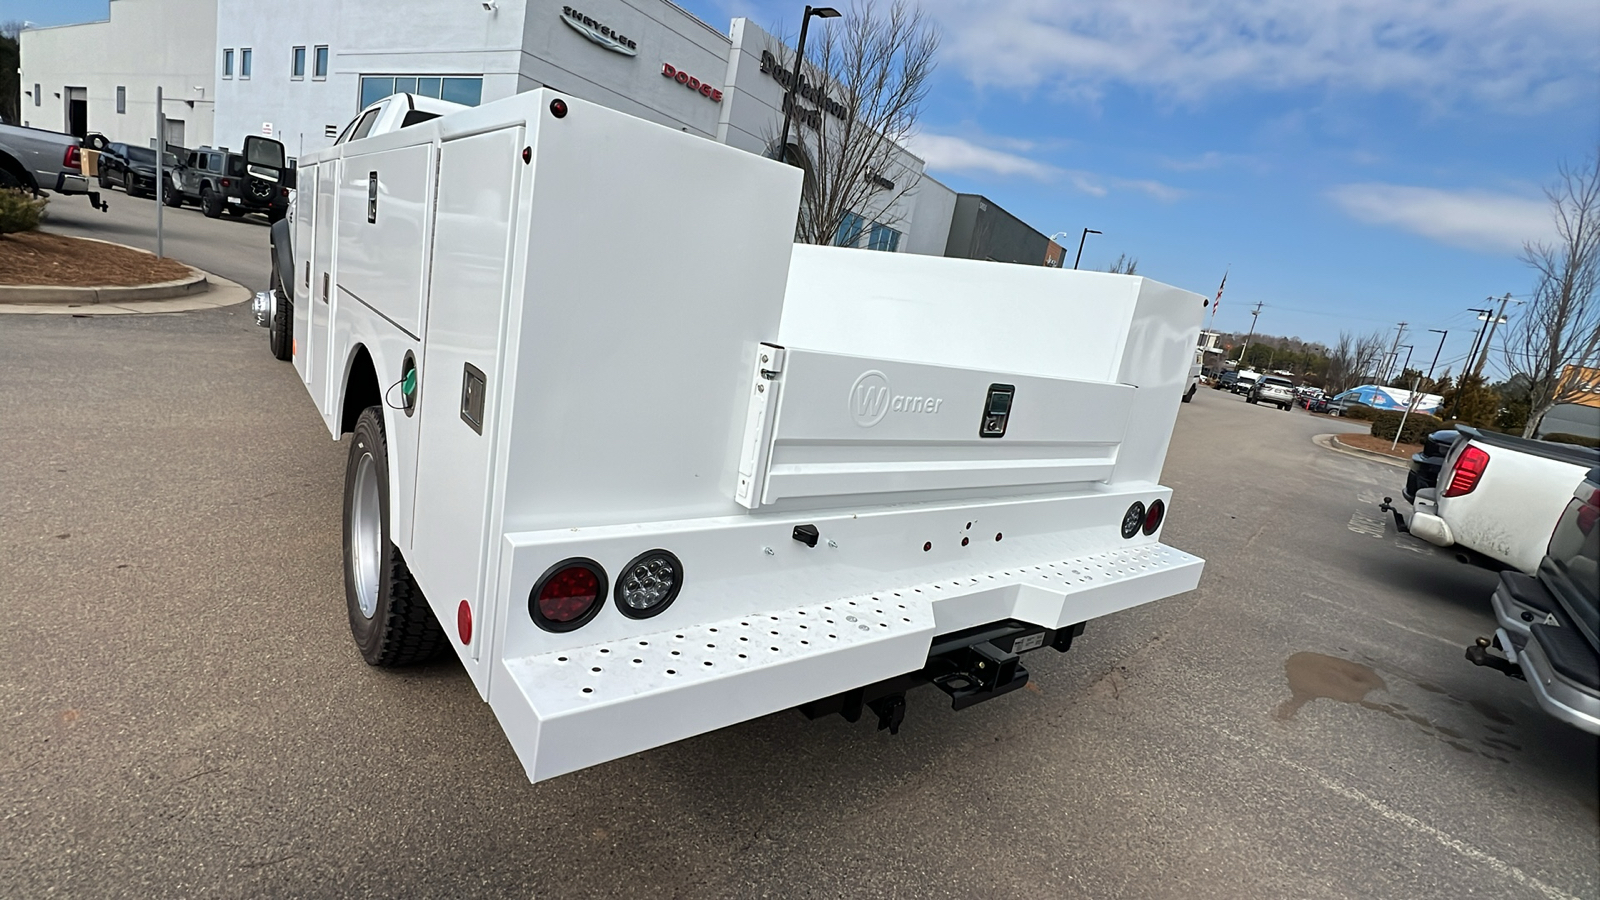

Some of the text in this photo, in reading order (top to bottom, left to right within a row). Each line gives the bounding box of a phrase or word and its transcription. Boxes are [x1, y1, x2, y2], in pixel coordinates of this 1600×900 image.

[562, 5, 637, 50] CHRYSLER
[661, 62, 723, 103] DODGE
[856, 383, 944, 418] Warner
